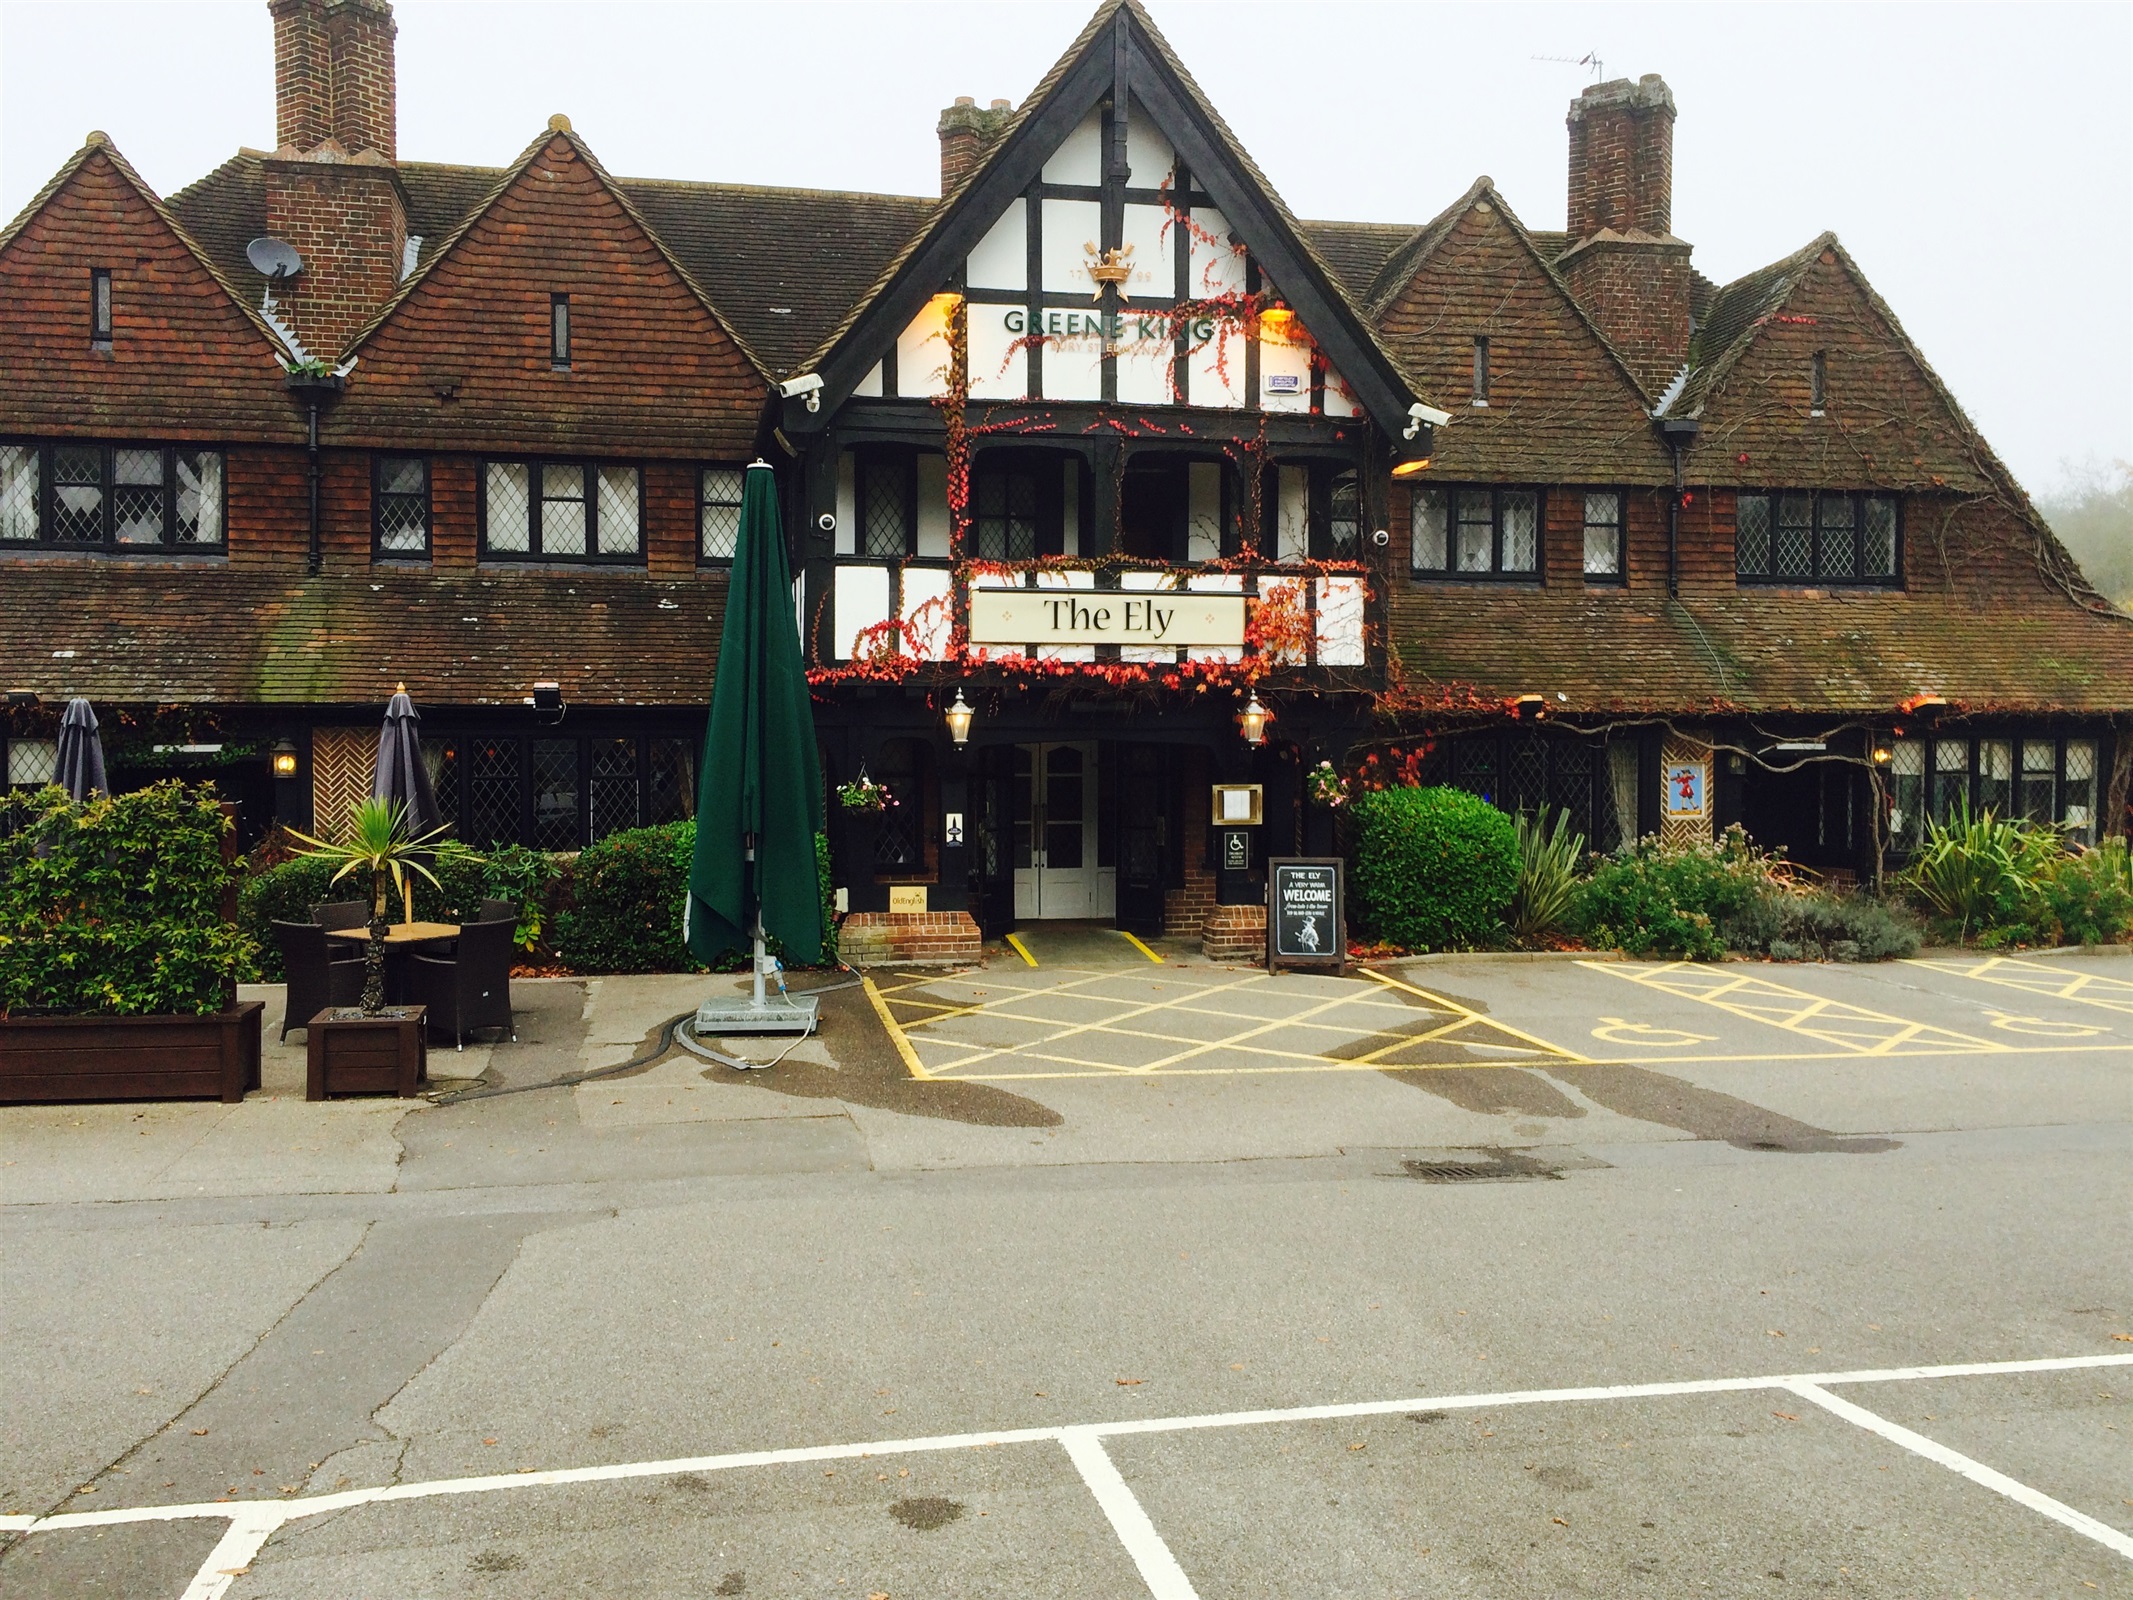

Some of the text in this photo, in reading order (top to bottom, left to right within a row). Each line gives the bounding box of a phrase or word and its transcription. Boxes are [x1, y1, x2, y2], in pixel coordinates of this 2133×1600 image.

[1004, 311, 1213, 341] GREENE KING
[1044, 598, 1174, 640] The Ely
[1283, 889, 1332, 902] WELCOME
